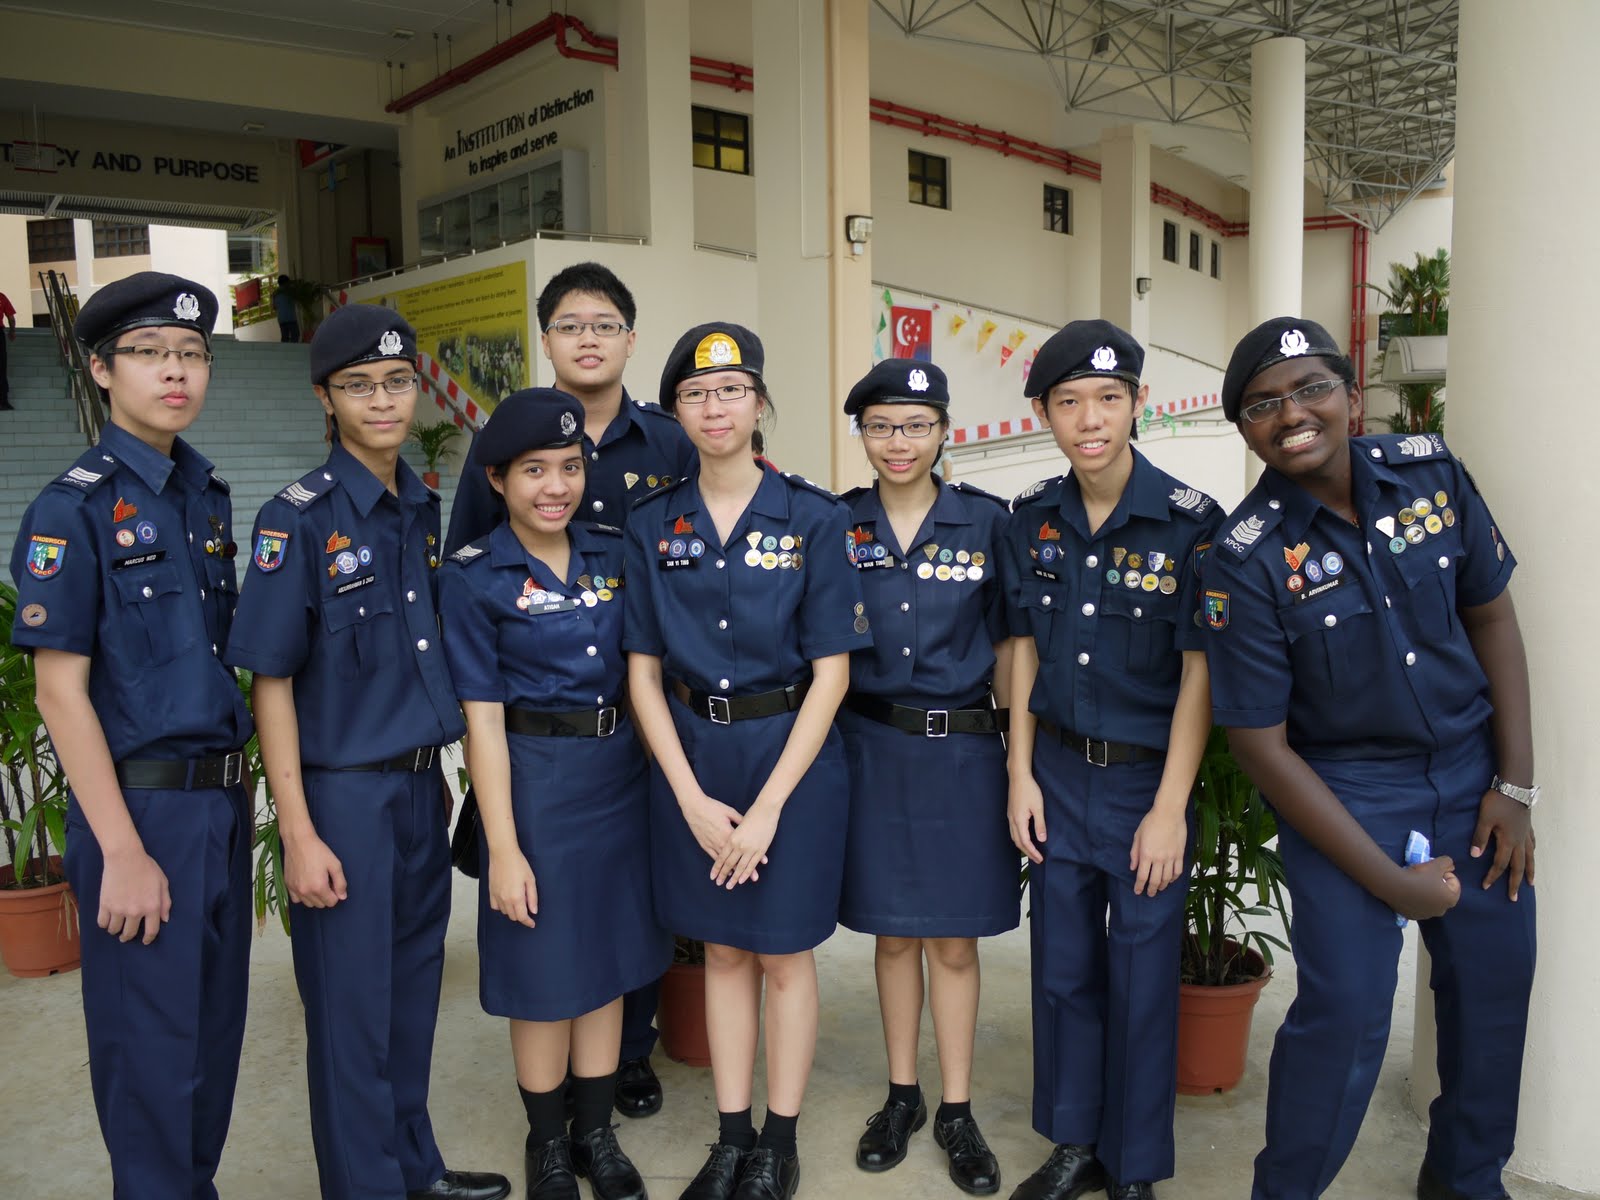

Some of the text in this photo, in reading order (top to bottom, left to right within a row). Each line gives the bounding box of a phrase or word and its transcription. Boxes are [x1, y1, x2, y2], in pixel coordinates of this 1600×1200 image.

[444, 146, 456, 162] An
[528, 107, 538, 127] of
[540, 88, 594, 123] Distinction
[468, 131, 558, 176] to inspire and serve
[92, 151, 141, 172] AND
[154, 157, 260, 183] PURPOSE
[1429, 434, 1444, 453] NPCC
[1195, 497, 1211, 514] NPCC
[31, 535, 67, 546] ANDERSON
[1224, 537, 1245, 553] NPCC
